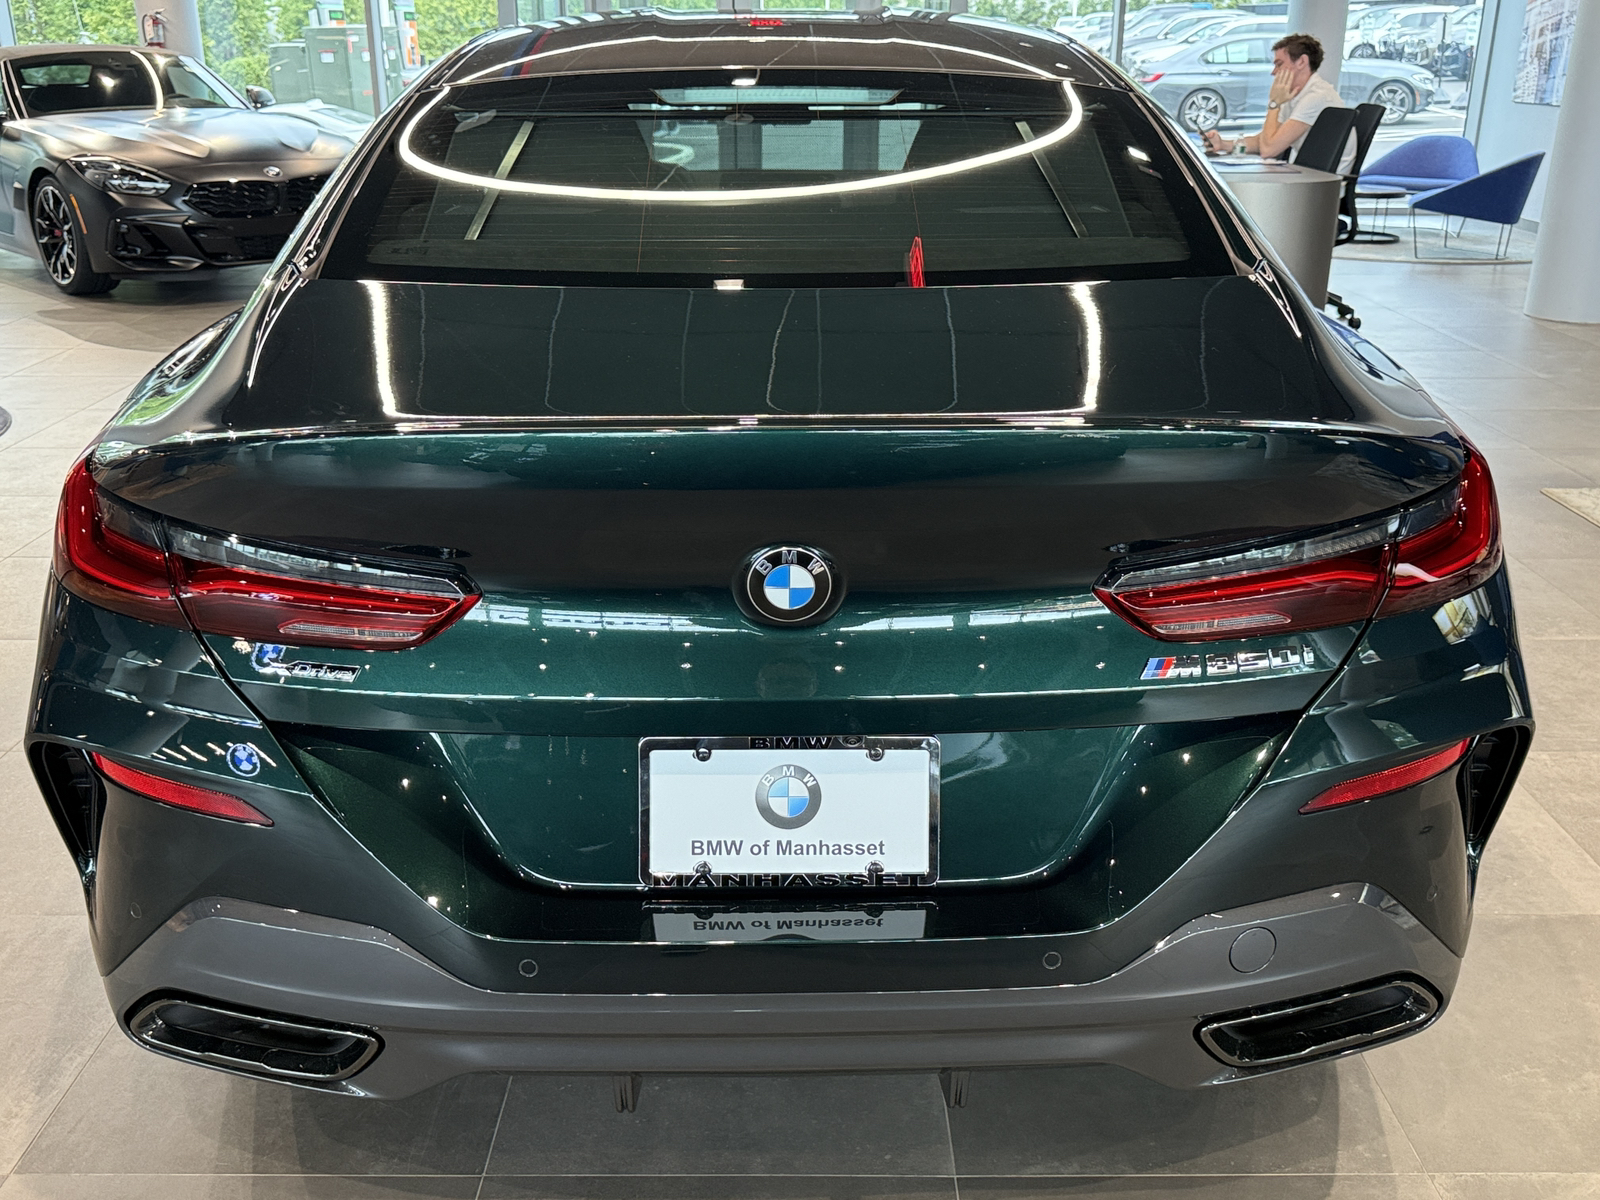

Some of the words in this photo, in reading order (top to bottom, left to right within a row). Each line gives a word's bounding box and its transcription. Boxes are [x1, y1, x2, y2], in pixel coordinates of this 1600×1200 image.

[756, 551, 825, 576] BMW
[749, 736, 834, 749] BMW
[761, 766, 817, 787] BMW
[691, 840, 743, 856] BMW
[750, 840, 770, 856] of
[776, 840, 885, 856] Manhasset
[652, 873, 929, 887] MANHASSET
